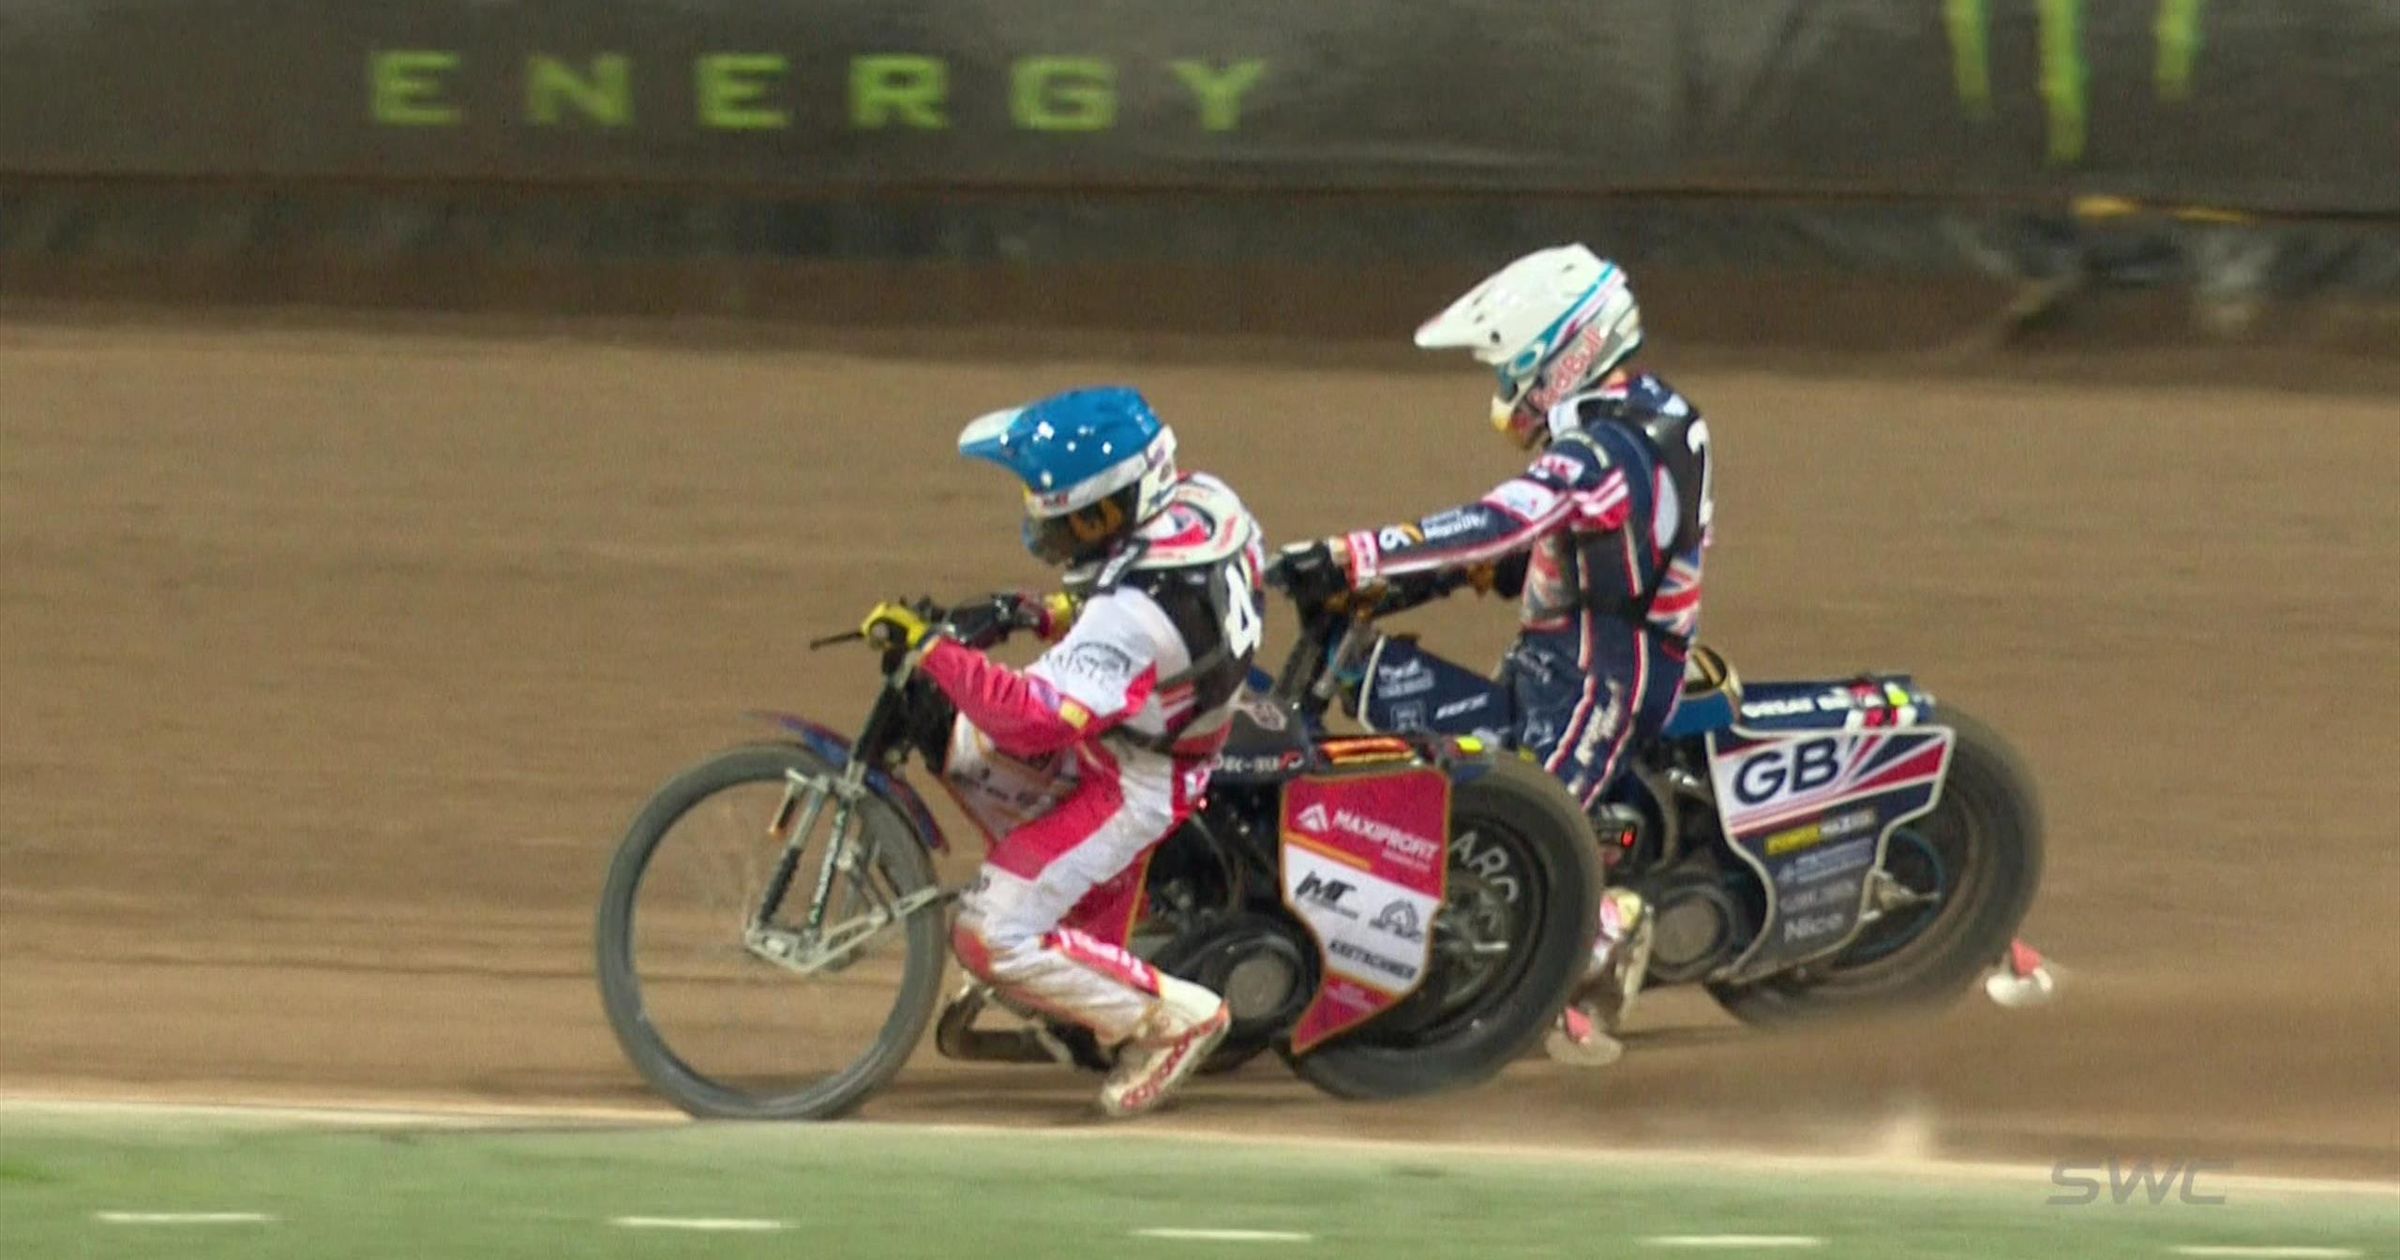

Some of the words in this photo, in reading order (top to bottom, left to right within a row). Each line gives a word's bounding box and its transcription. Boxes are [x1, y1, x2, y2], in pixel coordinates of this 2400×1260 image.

[369, 51, 1269, 130] ENERGY
[1224, 560, 1262, 659] 4
[1734, 736, 1839, 805] GB
